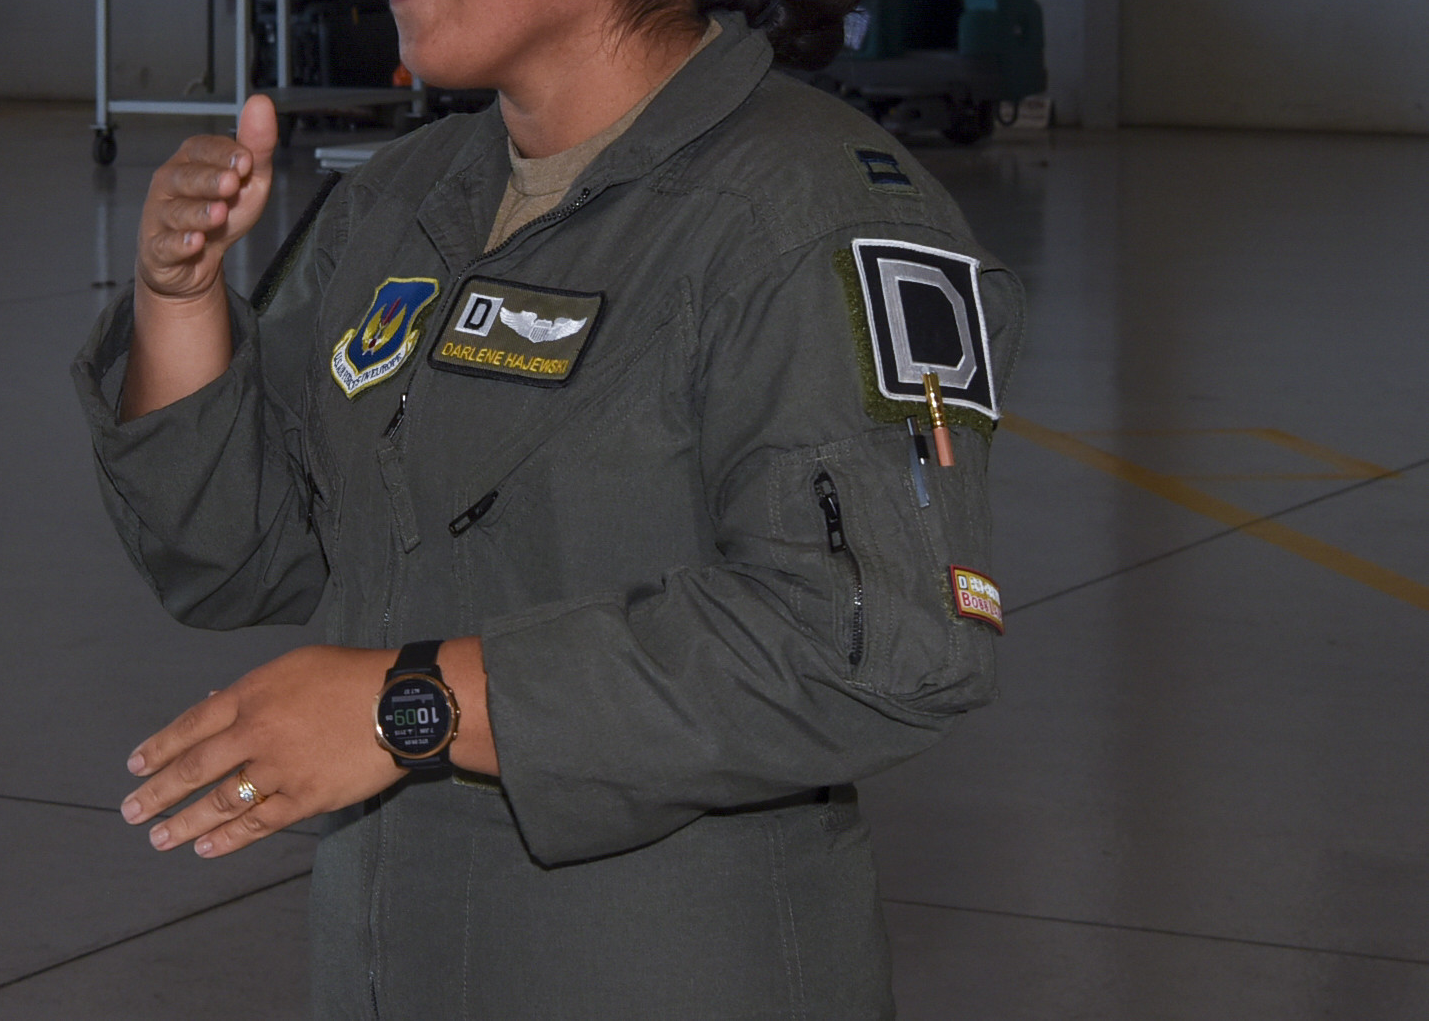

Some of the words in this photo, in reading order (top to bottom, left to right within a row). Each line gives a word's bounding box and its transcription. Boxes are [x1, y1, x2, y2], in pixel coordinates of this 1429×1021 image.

[463, 297, 493, 330] D
[877, 257, 977, 390] D
[361, 370, 371, 383] IN
[370, 352, 402, 379] EUROPE
[441, 342, 506, 365] DARLENE
[507, 353, 569, 374] HAJEWSKI
[394, 707, 440, 726] 1009
